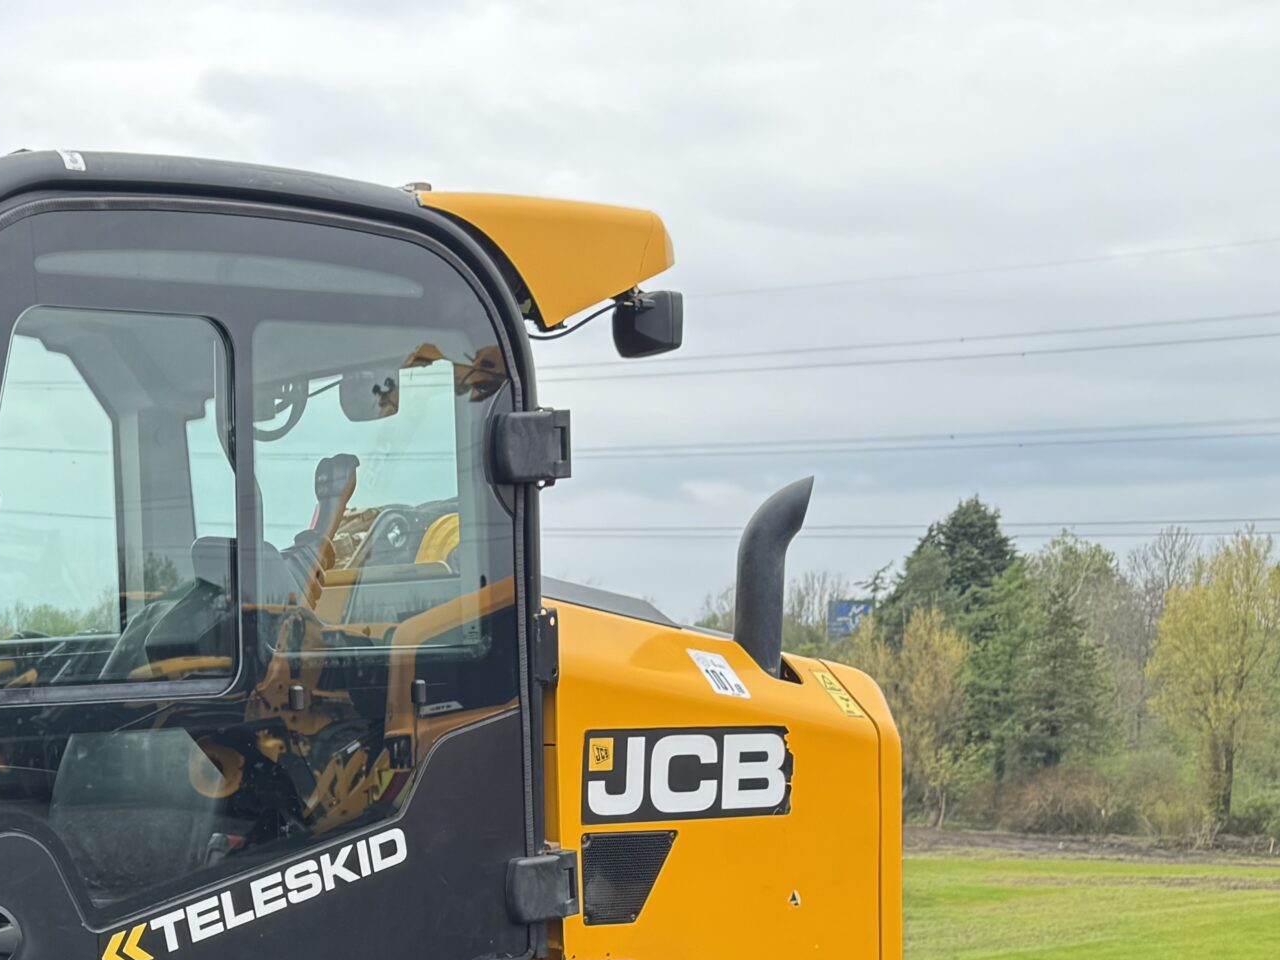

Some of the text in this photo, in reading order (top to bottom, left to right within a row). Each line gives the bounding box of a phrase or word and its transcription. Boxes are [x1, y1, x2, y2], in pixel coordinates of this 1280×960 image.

[705, 669, 735, 692] 101
[587, 733, 786, 816] JCB
[596, 747, 609, 762] JCB
[150, 828, 408, 952] TELESKID
